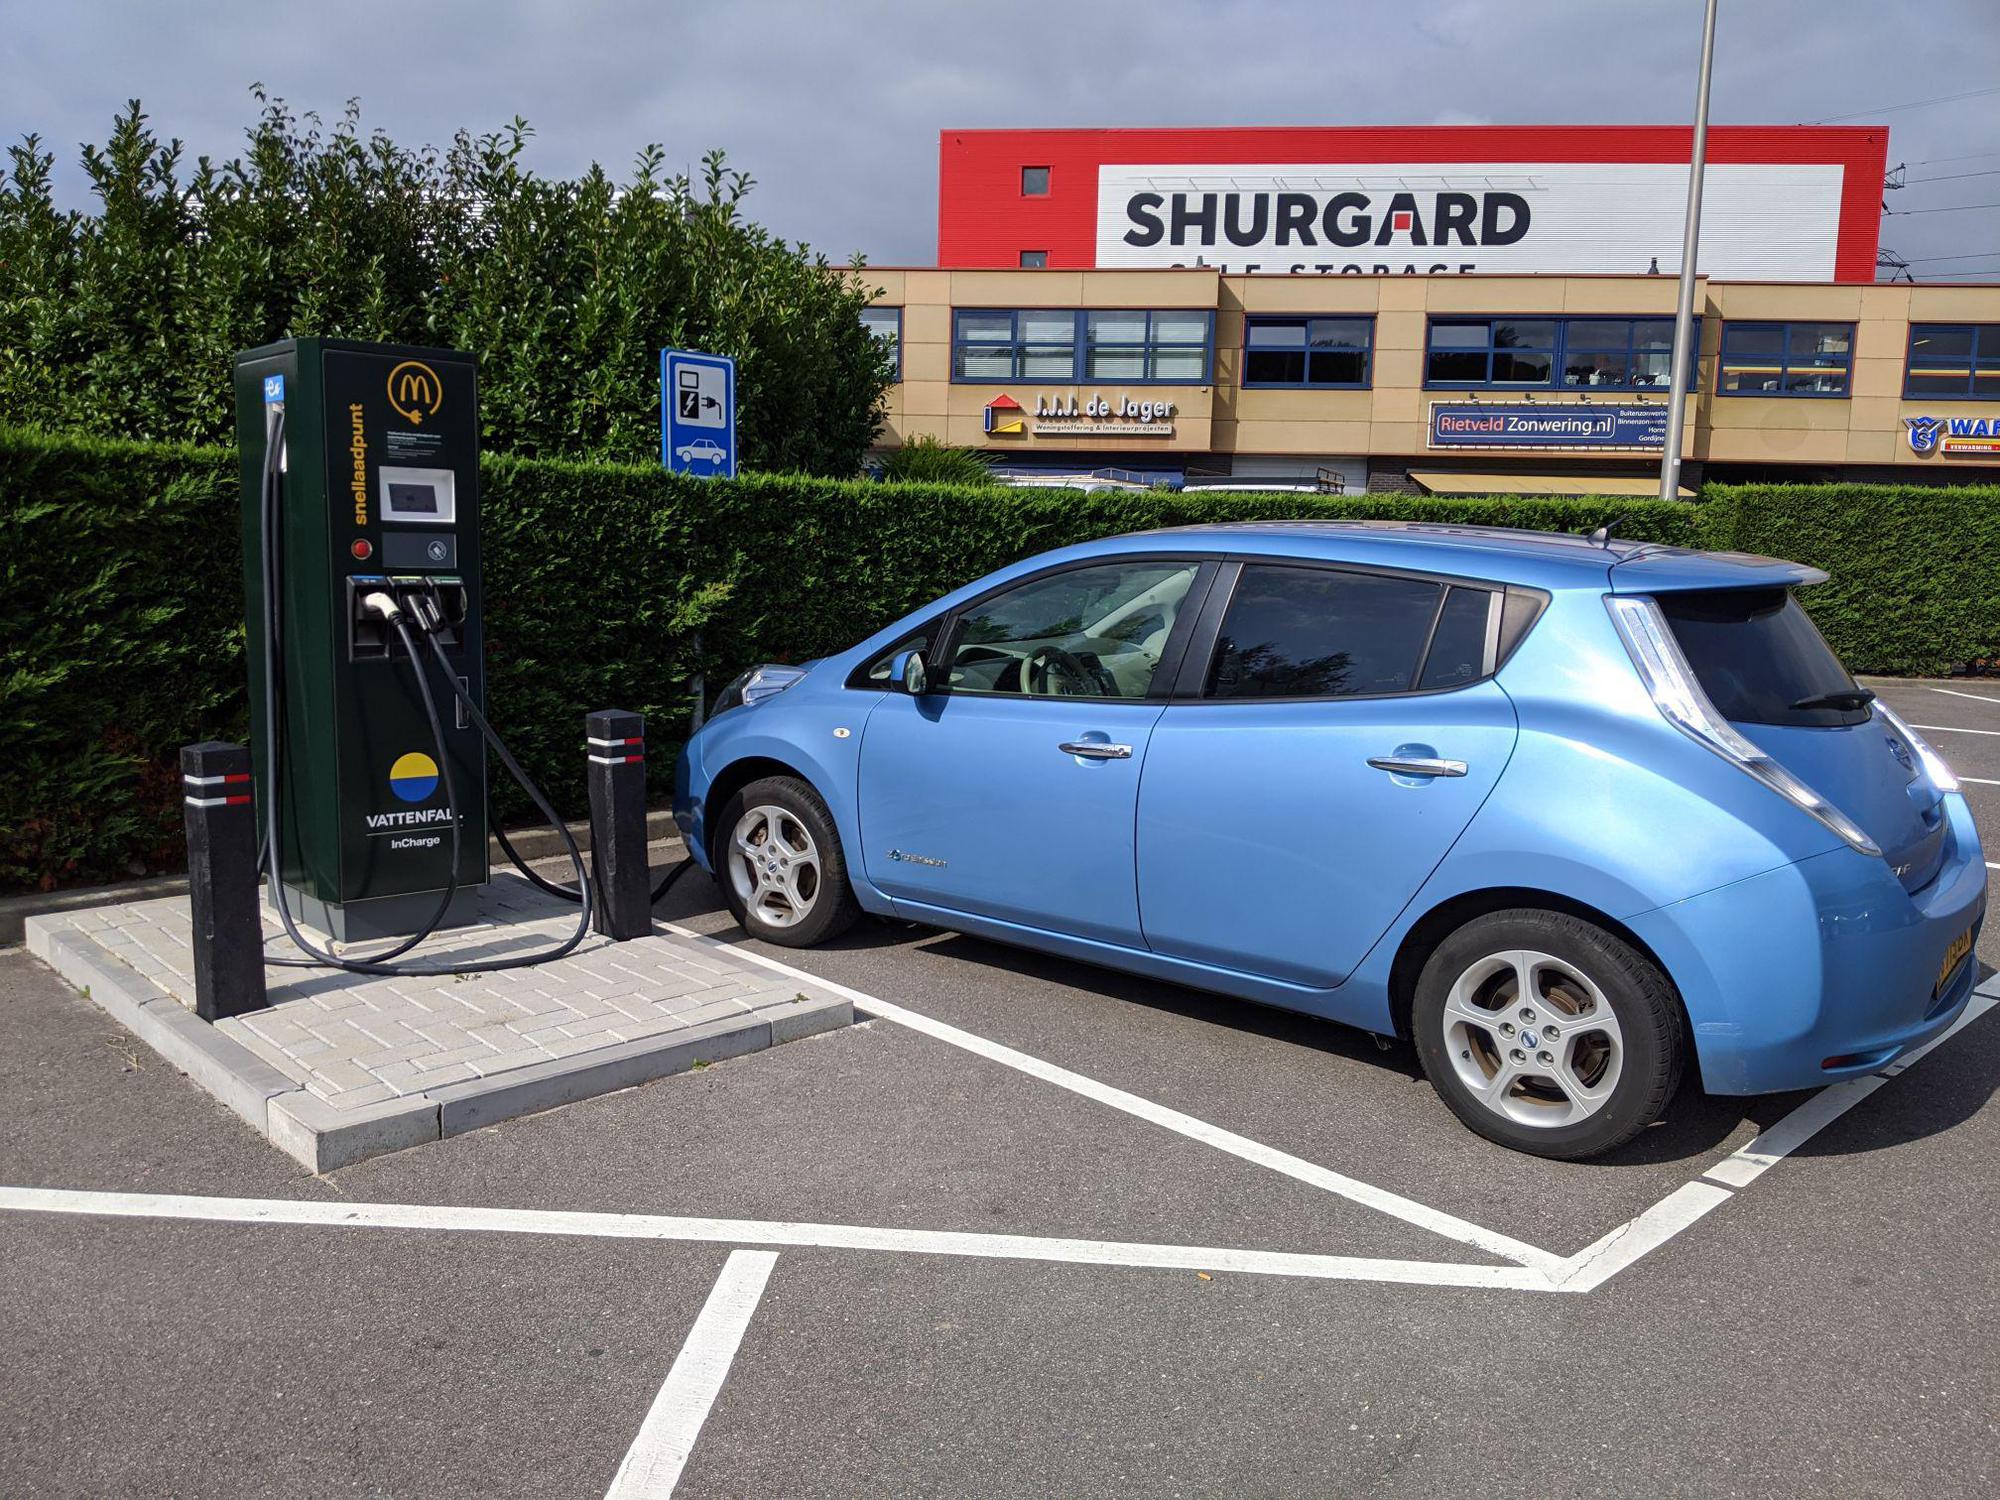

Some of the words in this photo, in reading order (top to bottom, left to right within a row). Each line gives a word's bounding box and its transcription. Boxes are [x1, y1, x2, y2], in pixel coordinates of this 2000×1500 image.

[1122, 191, 1531, 248] SHURGARD
[1035, 393, 1078, 417] J.J.J.
[1086, 393, 1110, 418] de
[1117, 394, 1174, 424] Jager
[1441, 416, 1504, 432] Rietveld
[1507, 416, 1611, 436] Zonwering.nl
[349, 403, 368, 526] snellaadpunt
[366, 808, 463, 828] VATTENFAL
[391, 836, 441, 849] InCharge
